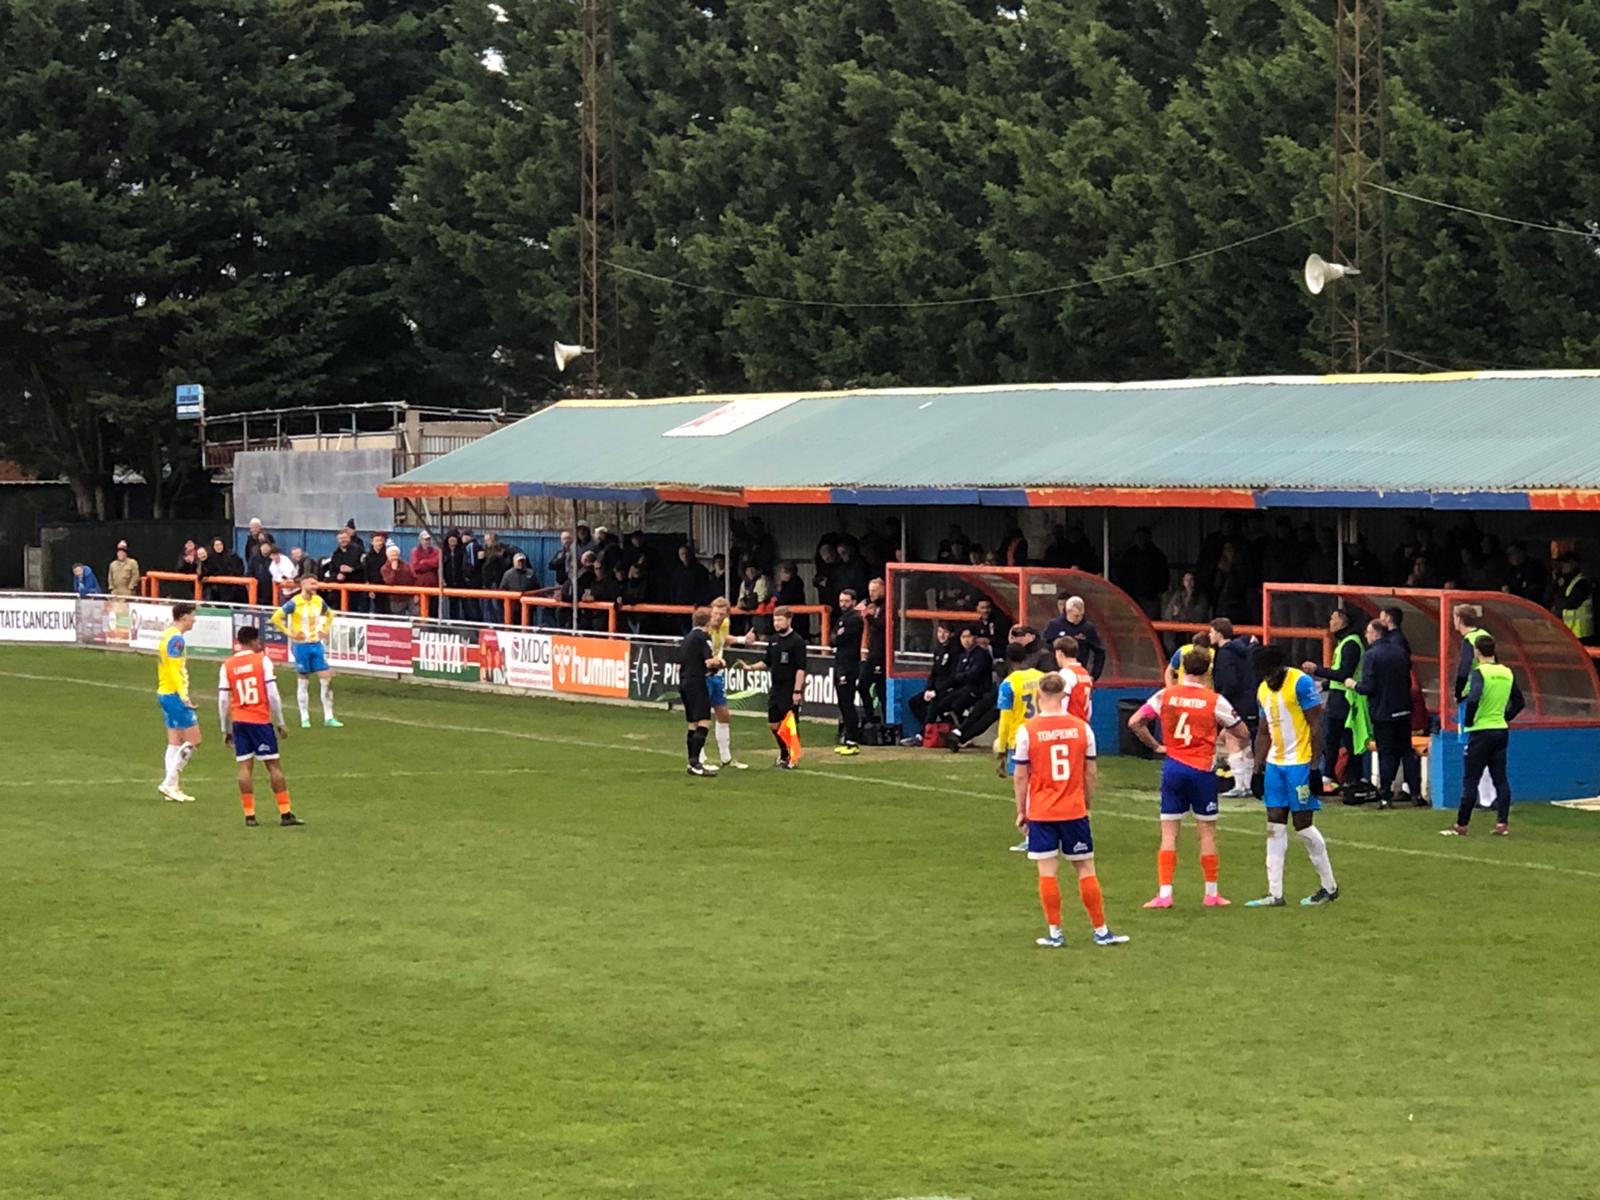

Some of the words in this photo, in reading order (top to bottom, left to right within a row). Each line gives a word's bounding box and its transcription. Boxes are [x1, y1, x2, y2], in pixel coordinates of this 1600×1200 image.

[22, 610, 60, 630] CANCER
[62, 611, 77, 630] UK
[419, 631, 462, 674] KENYA
[521, 637, 550, 665] MDG
[570, 645, 630, 690] hummel
[641, 662, 649, 684] P
[722, 667, 745, 691] IGN
[235, 676, 260, 706] 16
[804, 667, 839, 704] and
[1022, 690, 1041, 719] 3
[1036, 727, 1080, 743] TOMPKINS
[1173, 711, 1194, 747] 4
[1050, 743, 1071, 782] 6
